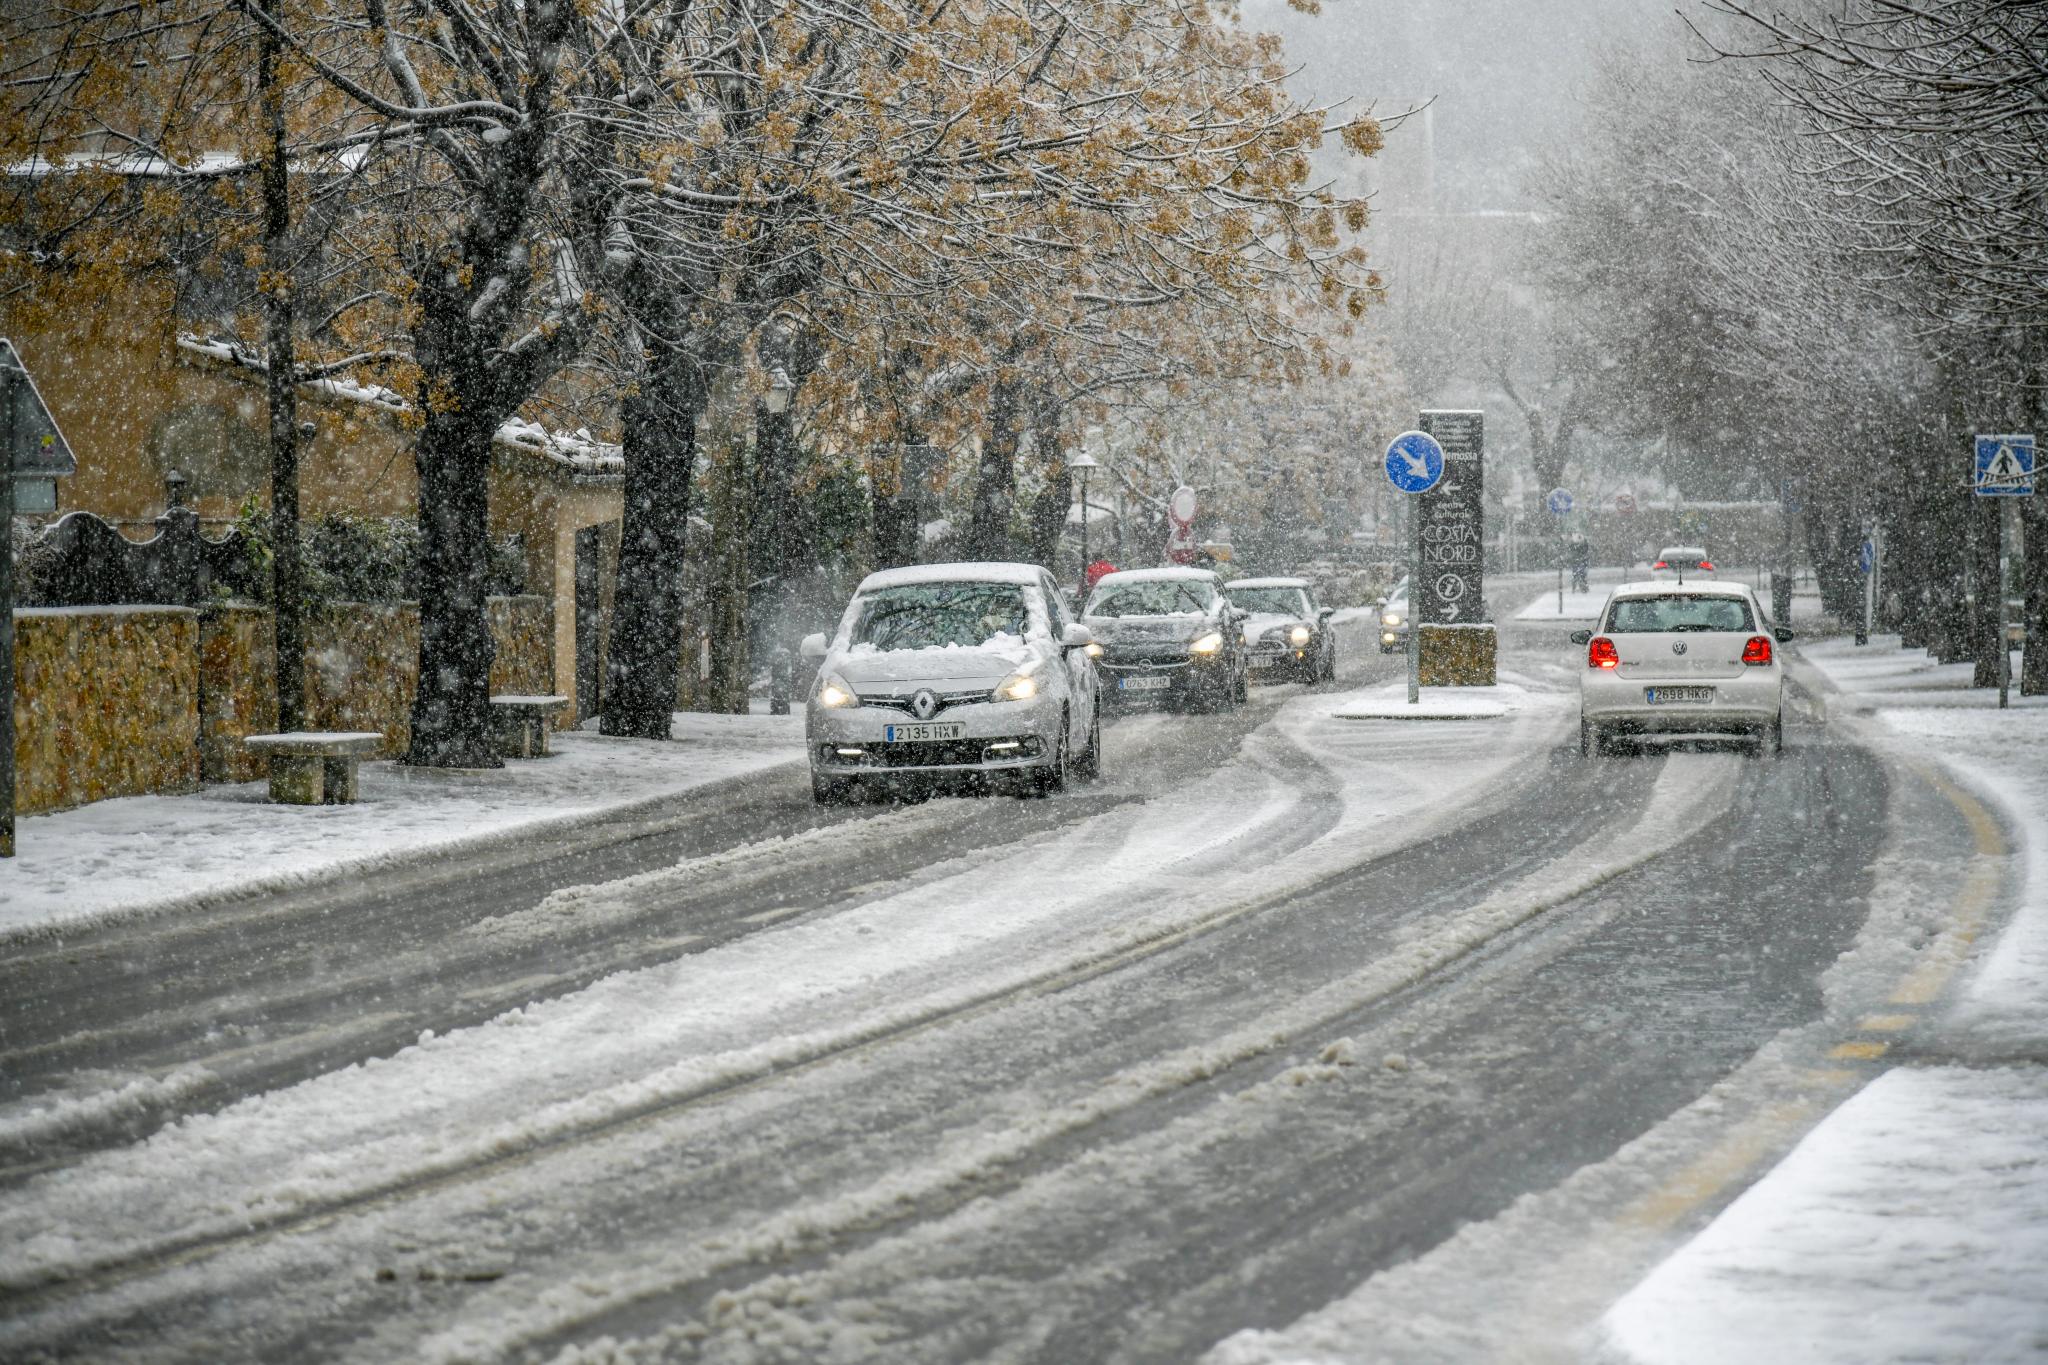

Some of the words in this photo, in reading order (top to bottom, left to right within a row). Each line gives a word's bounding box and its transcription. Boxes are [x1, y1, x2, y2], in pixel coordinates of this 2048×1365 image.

[1423, 525, 1477, 542] COSTA
[1424, 544, 1476, 561] NORD
[1656, 689, 1684, 700] 2698
[896, 727, 930, 740] 2135
[934, 725, 959, 738] HXW
